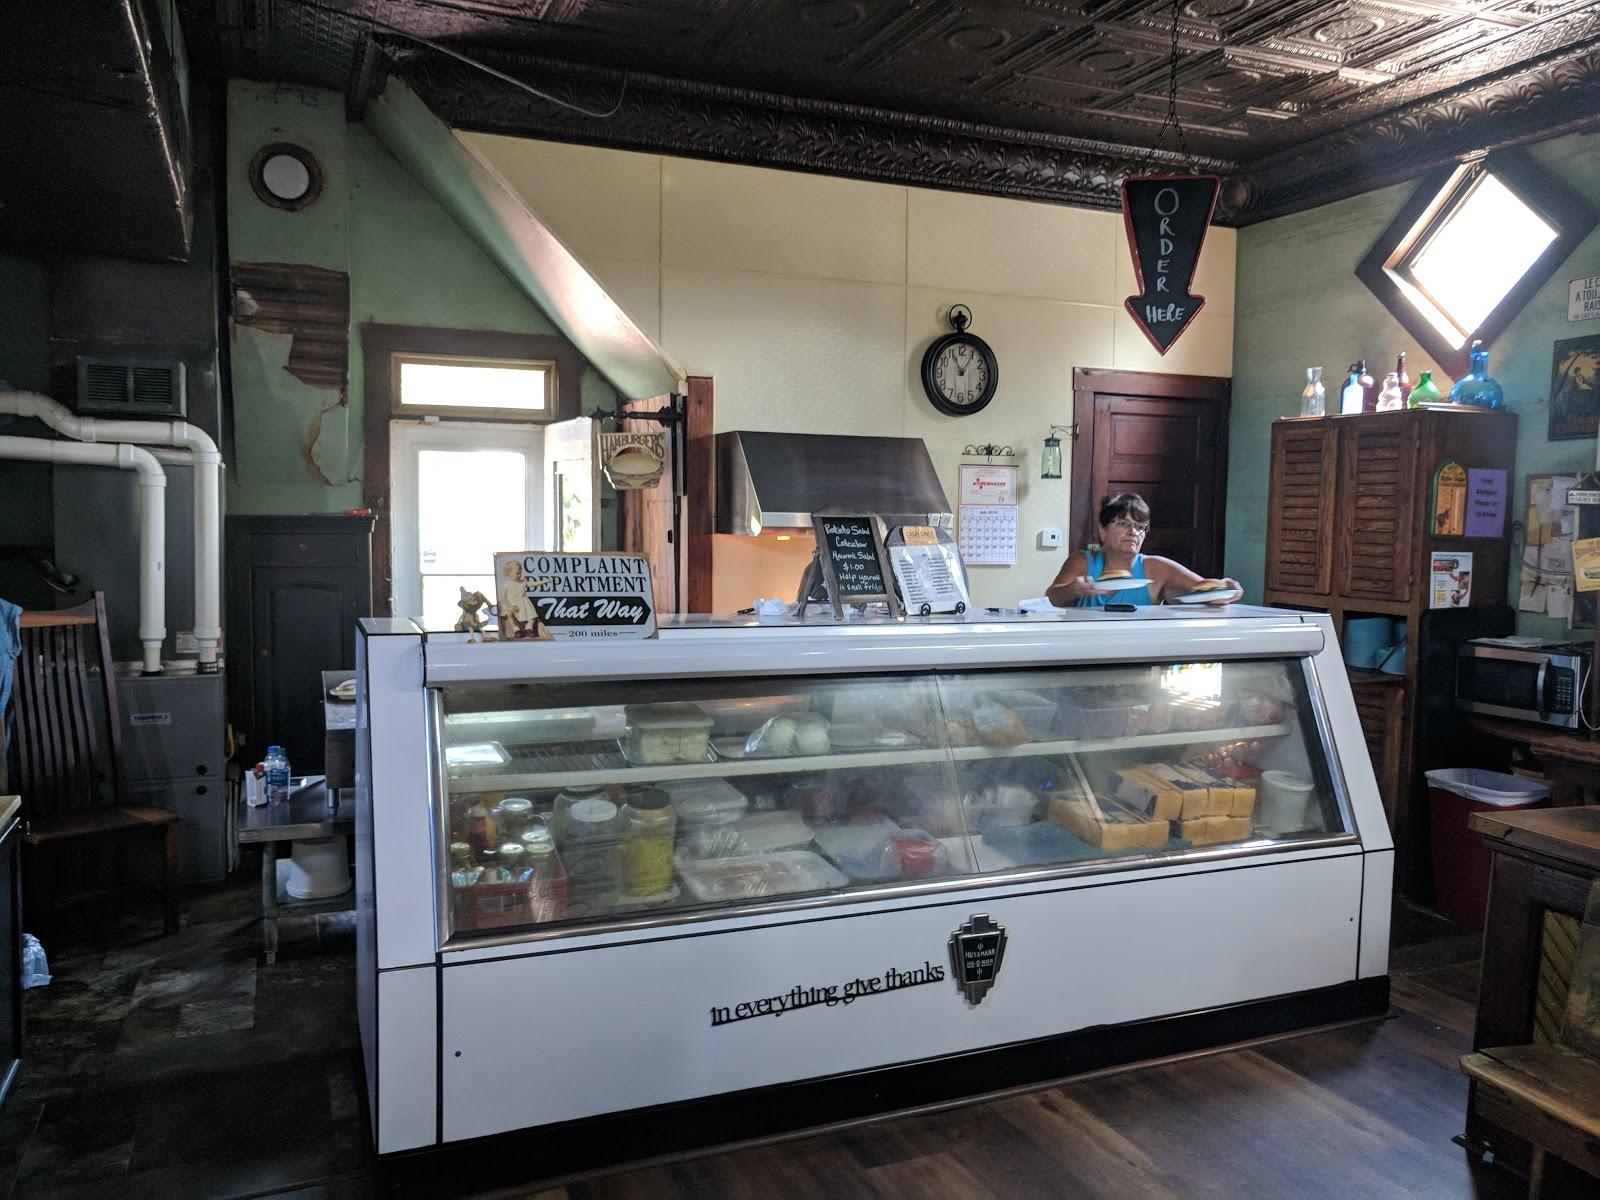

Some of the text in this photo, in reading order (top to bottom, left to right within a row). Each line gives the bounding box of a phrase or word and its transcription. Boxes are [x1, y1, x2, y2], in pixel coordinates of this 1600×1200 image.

[1154, 187, 1179, 293] ORDER
[1575, 291, 1581, 302] A
[1146, 303, 1186, 323] HERE
[948, 348, 955, 359] 11
[958, 344, 967, 356] 12
[969, 350, 975, 361] 1
[940, 355, 949, 368] 10
[977, 359, 984, 370] 2
[936, 367, 943, 378] 9
[979, 370, 986, 381] 3
[940, 379, 946, 390] 8
[975, 382, 982, 393] 4
[947, 388, 954, 400] 7
[957, 392, 964, 404] 6
[967, 390, 974, 401] 5
[600, 433, 665, 464] HAMBURGERS
[824, 523, 870, 536] Potato Salad
[857, 551, 876, 561] Salad
[523, 556, 645, 575] COMPLAINT
[842, 561, 865, 573] $1.00
[839, 572, 857, 582] Help
[525, 576, 647, 593] DEPARTMENT
[537, 597, 644, 624] That Way
[568, 629, 619, 638] 200 miles
[965, 947, 996, 959] HUSSMANN
[711, 961, 945, 1025] in everything give thanks
